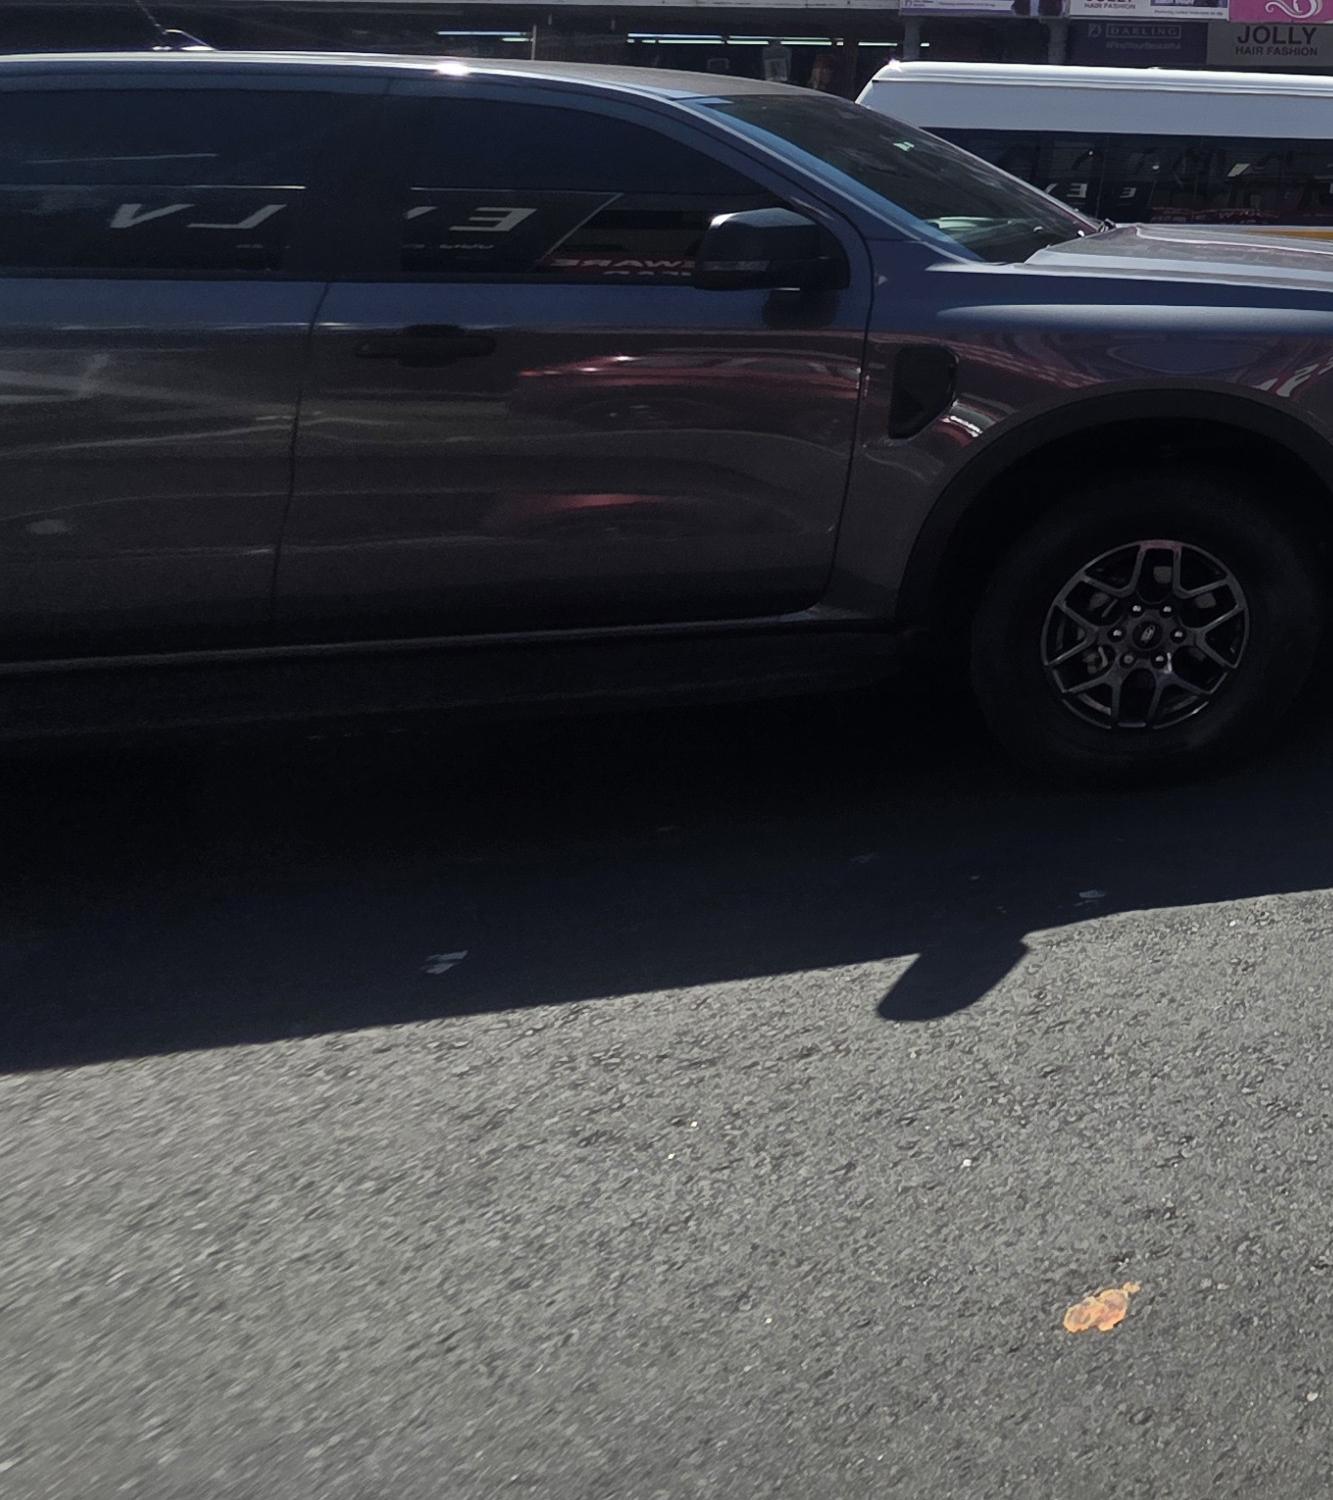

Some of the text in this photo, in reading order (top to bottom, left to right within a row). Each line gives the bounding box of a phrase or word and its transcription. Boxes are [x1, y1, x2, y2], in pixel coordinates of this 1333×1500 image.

[1110, 25, 1179, 37] DARLING
[1237, 25, 1318, 45] JOLLY
[1235, 46, 1319, 57] HAIR FASHION
